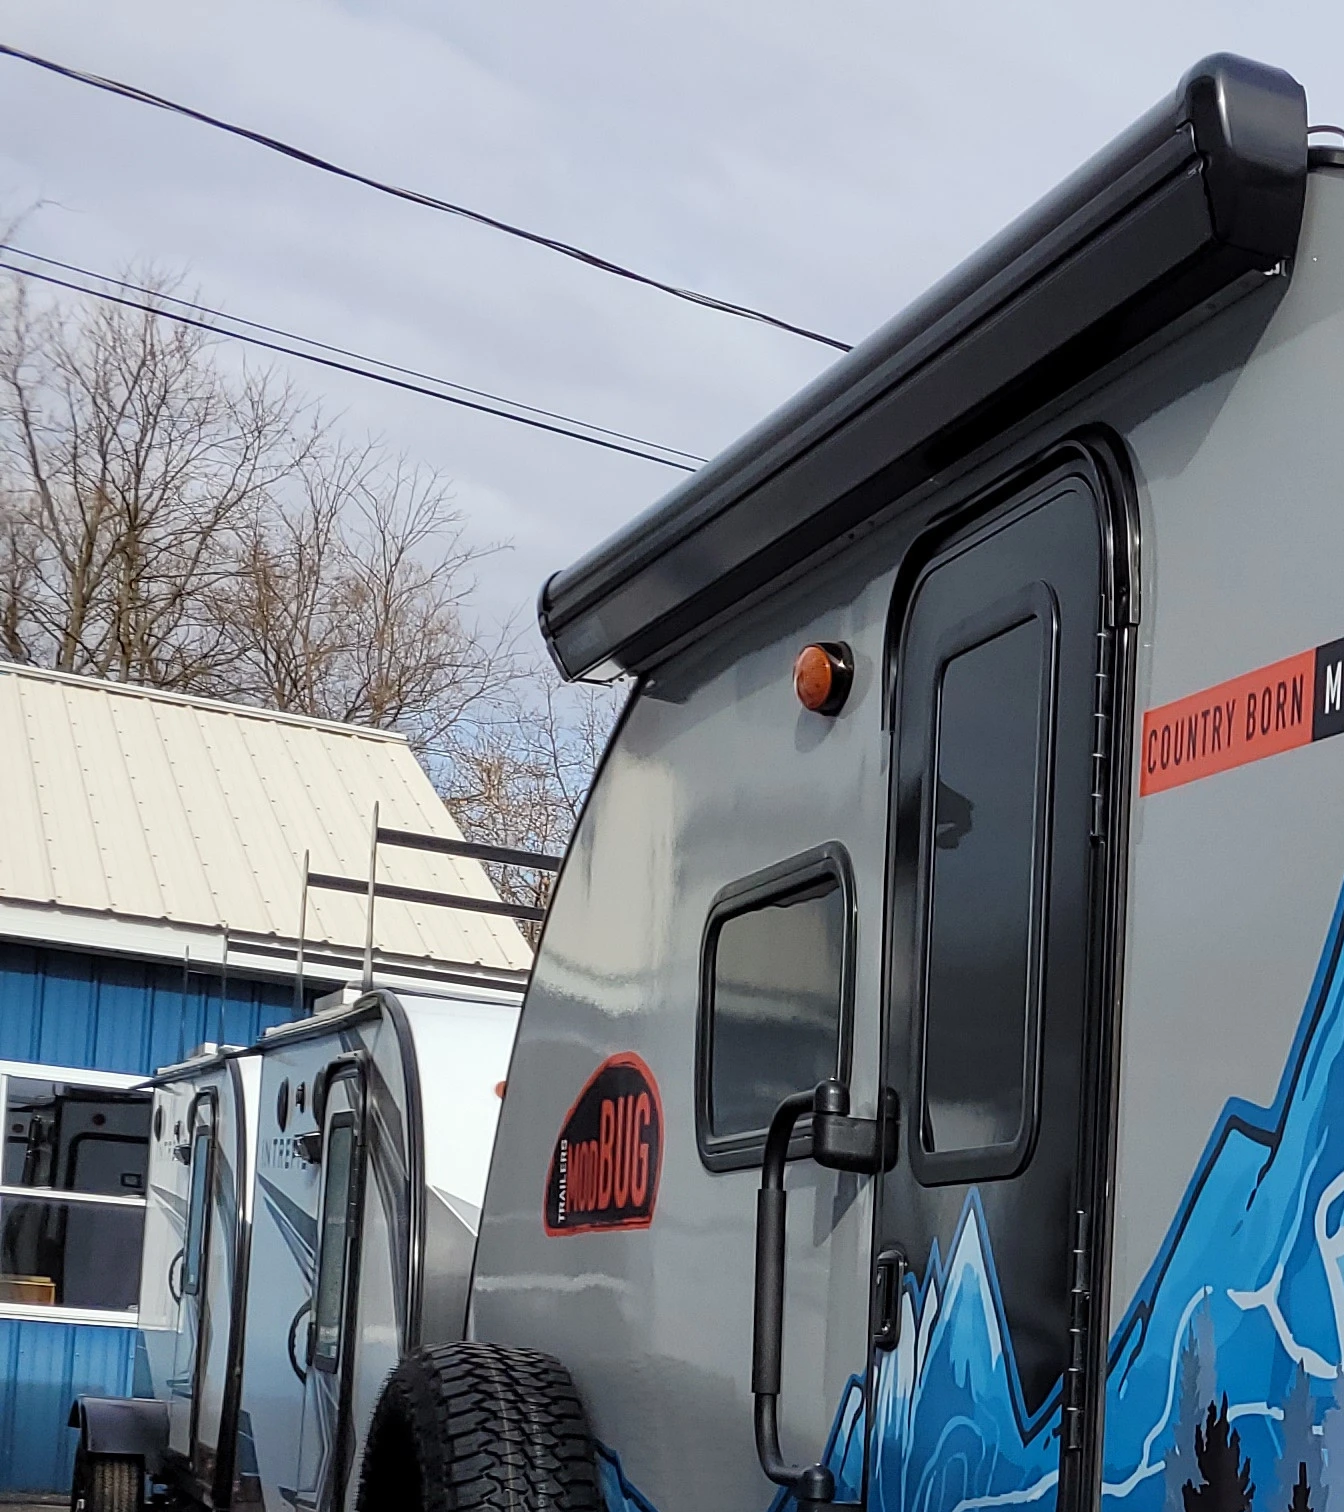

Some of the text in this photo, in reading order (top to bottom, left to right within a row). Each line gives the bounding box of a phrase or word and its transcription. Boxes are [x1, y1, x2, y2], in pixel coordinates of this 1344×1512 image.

[1147, 703, 1236, 774] COUNTRY
[1245, 673, 1304, 742] BORN
[558, 1139, 568, 1224] TRAILERS
